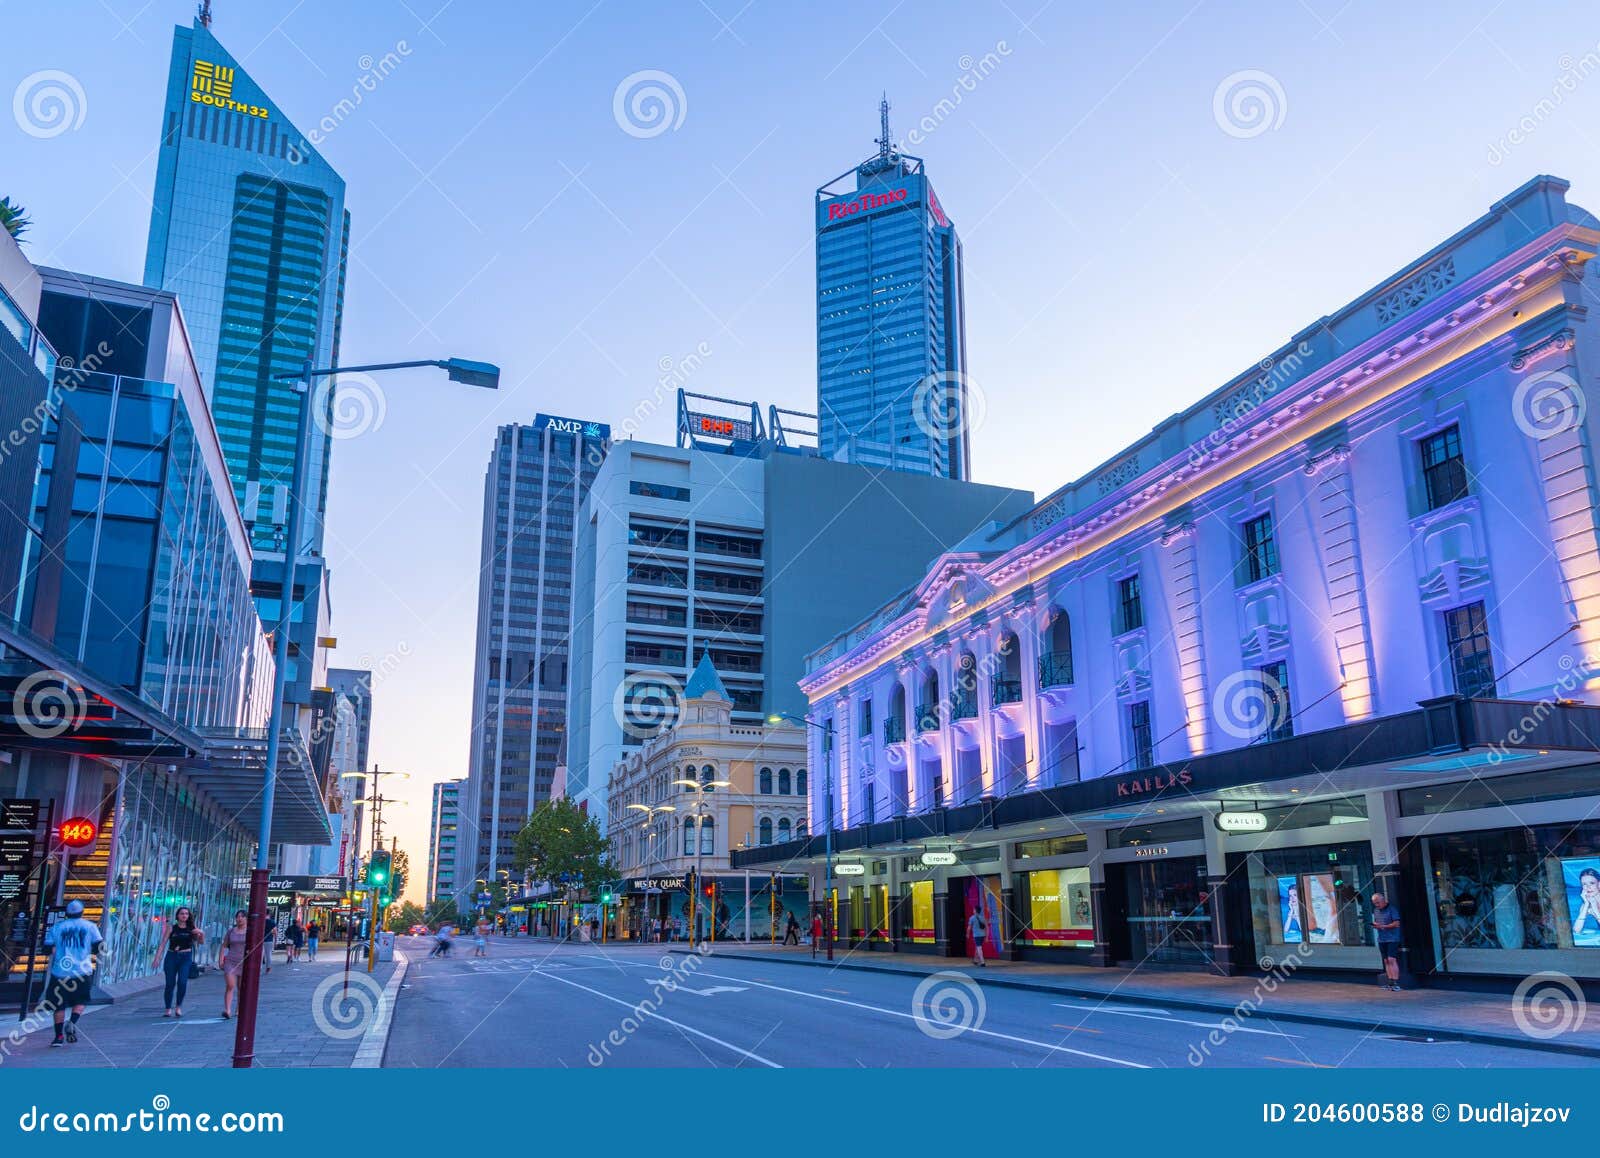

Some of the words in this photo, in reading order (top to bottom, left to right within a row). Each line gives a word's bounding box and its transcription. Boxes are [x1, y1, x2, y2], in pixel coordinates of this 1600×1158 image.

[547, 418, 582, 434] AMP
[701, 417, 734, 434] BHP
[1117, 769, 1193, 797] KAILIS
[1227, 817, 1261, 825] KAILIS
[1136, 848, 1168, 857] KAILIS
